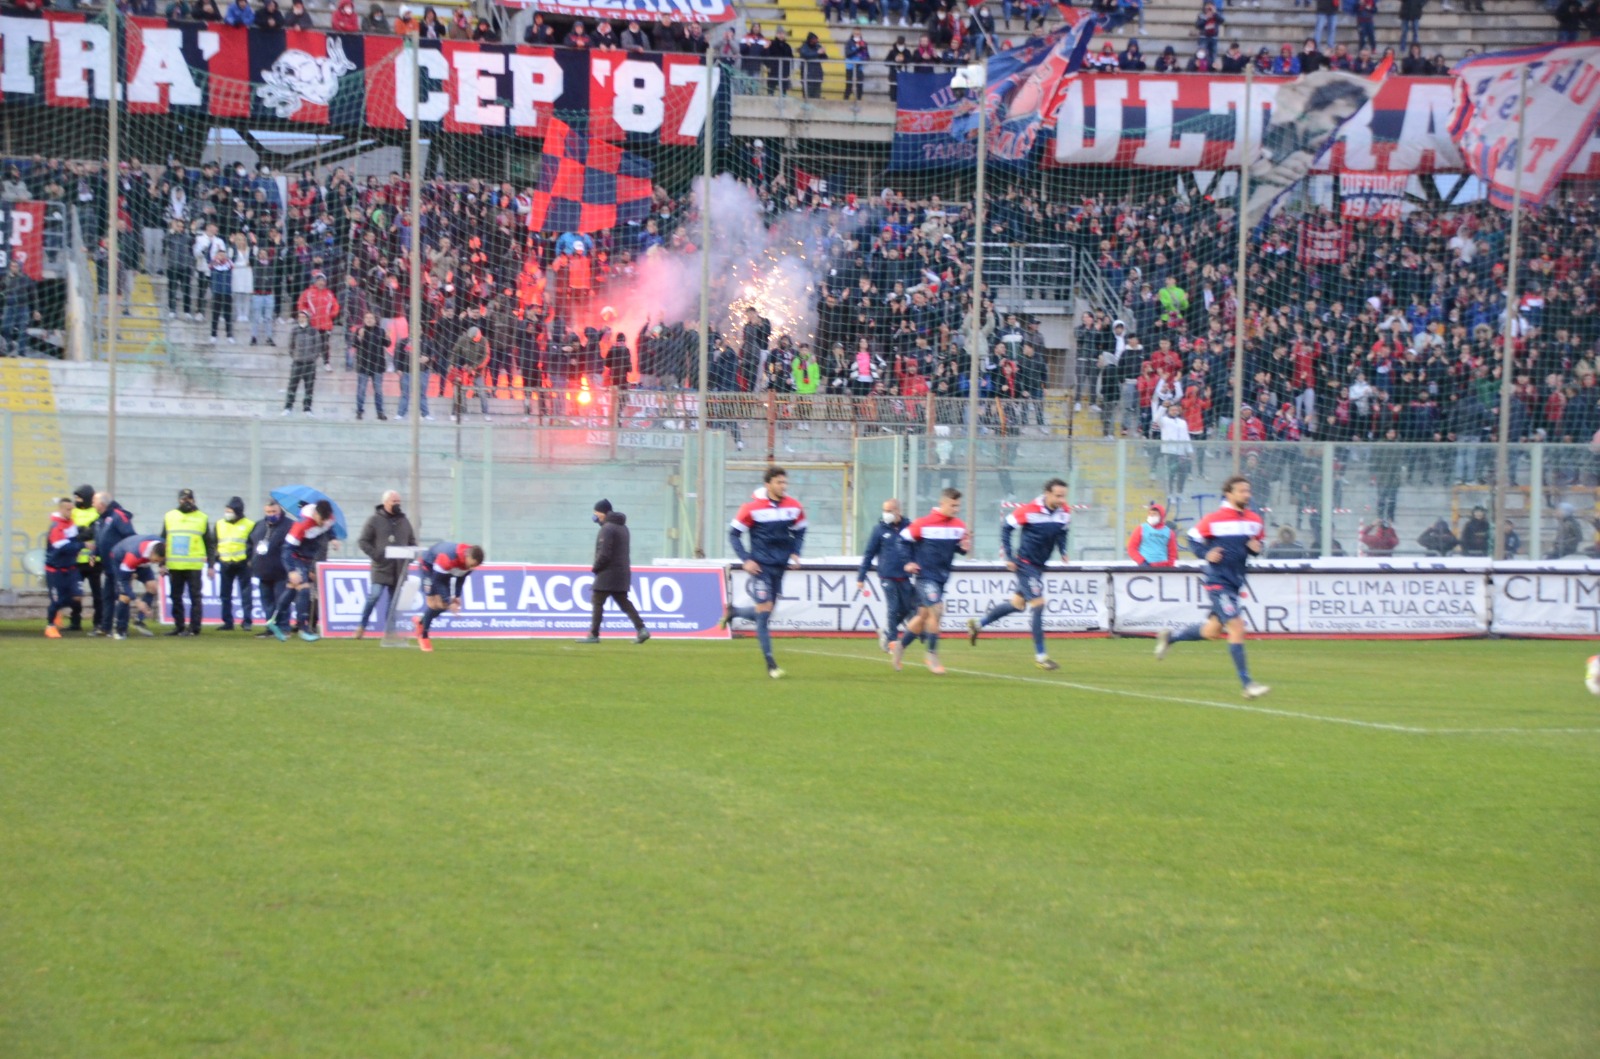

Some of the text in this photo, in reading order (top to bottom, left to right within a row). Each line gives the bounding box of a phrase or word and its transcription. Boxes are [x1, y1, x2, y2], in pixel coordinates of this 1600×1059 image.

[395, 48, 563, 126] CEP
[592, 59, 719, 136] '87
[590, 430, 646, 446] SEPRE
[516, 574, 684, 613] ACCIO
[1040, 579, 1098, 595] EALE
[1126, 574, 1258, 604] CLIA
[1308, 580, 1476, 596] IL CLIMA IDEALE
[945, 599, 969, 614] ER
[1047, 599, 1098, 614] CASA
[1308, 599, 1477, 615] PER LA TUA CASA
